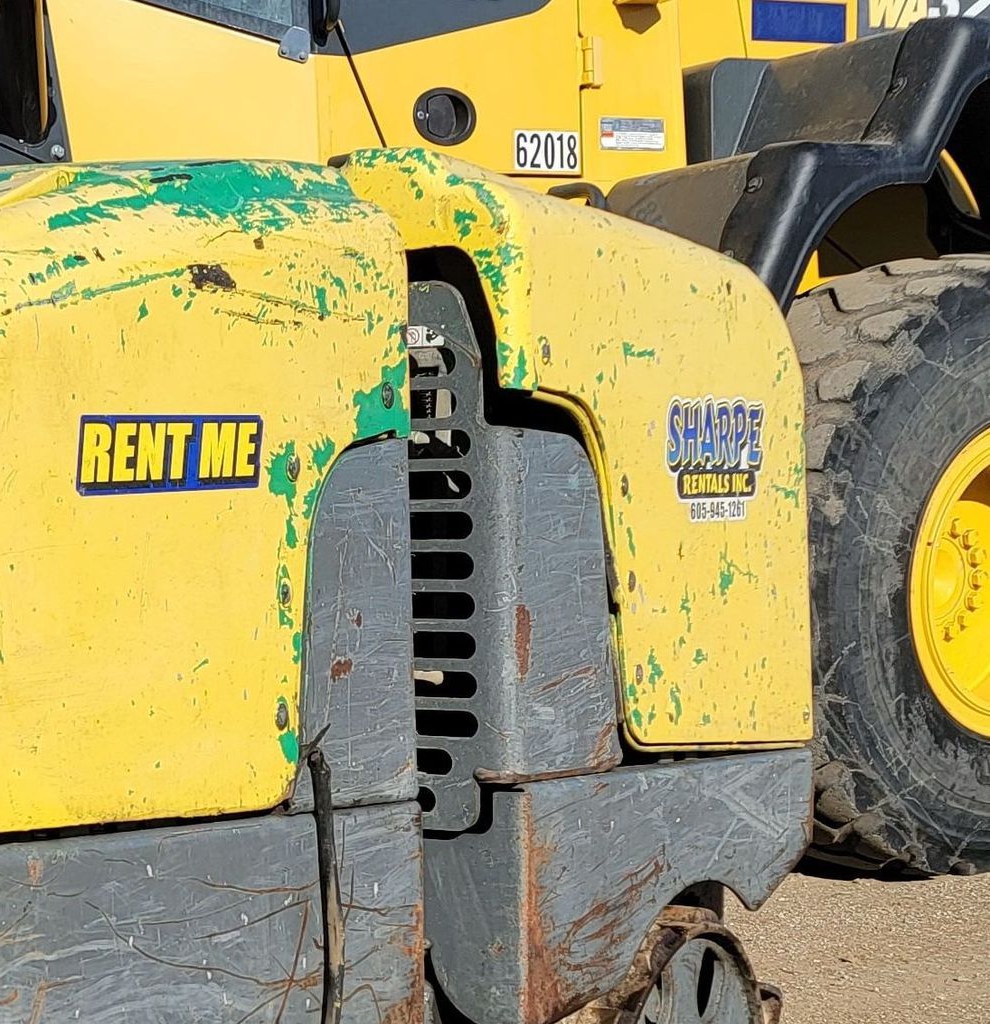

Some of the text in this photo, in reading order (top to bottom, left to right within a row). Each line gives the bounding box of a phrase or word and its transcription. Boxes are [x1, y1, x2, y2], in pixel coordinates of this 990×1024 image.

[516, 132, 578, 169] 62018
[79, 421, 259, 483] RENT ME
[667, 398, 764, 472] SHARPE
[682, 473, 752, 495] RENTALS INC.
[690, 500, 745, 519] 605-945-1261
